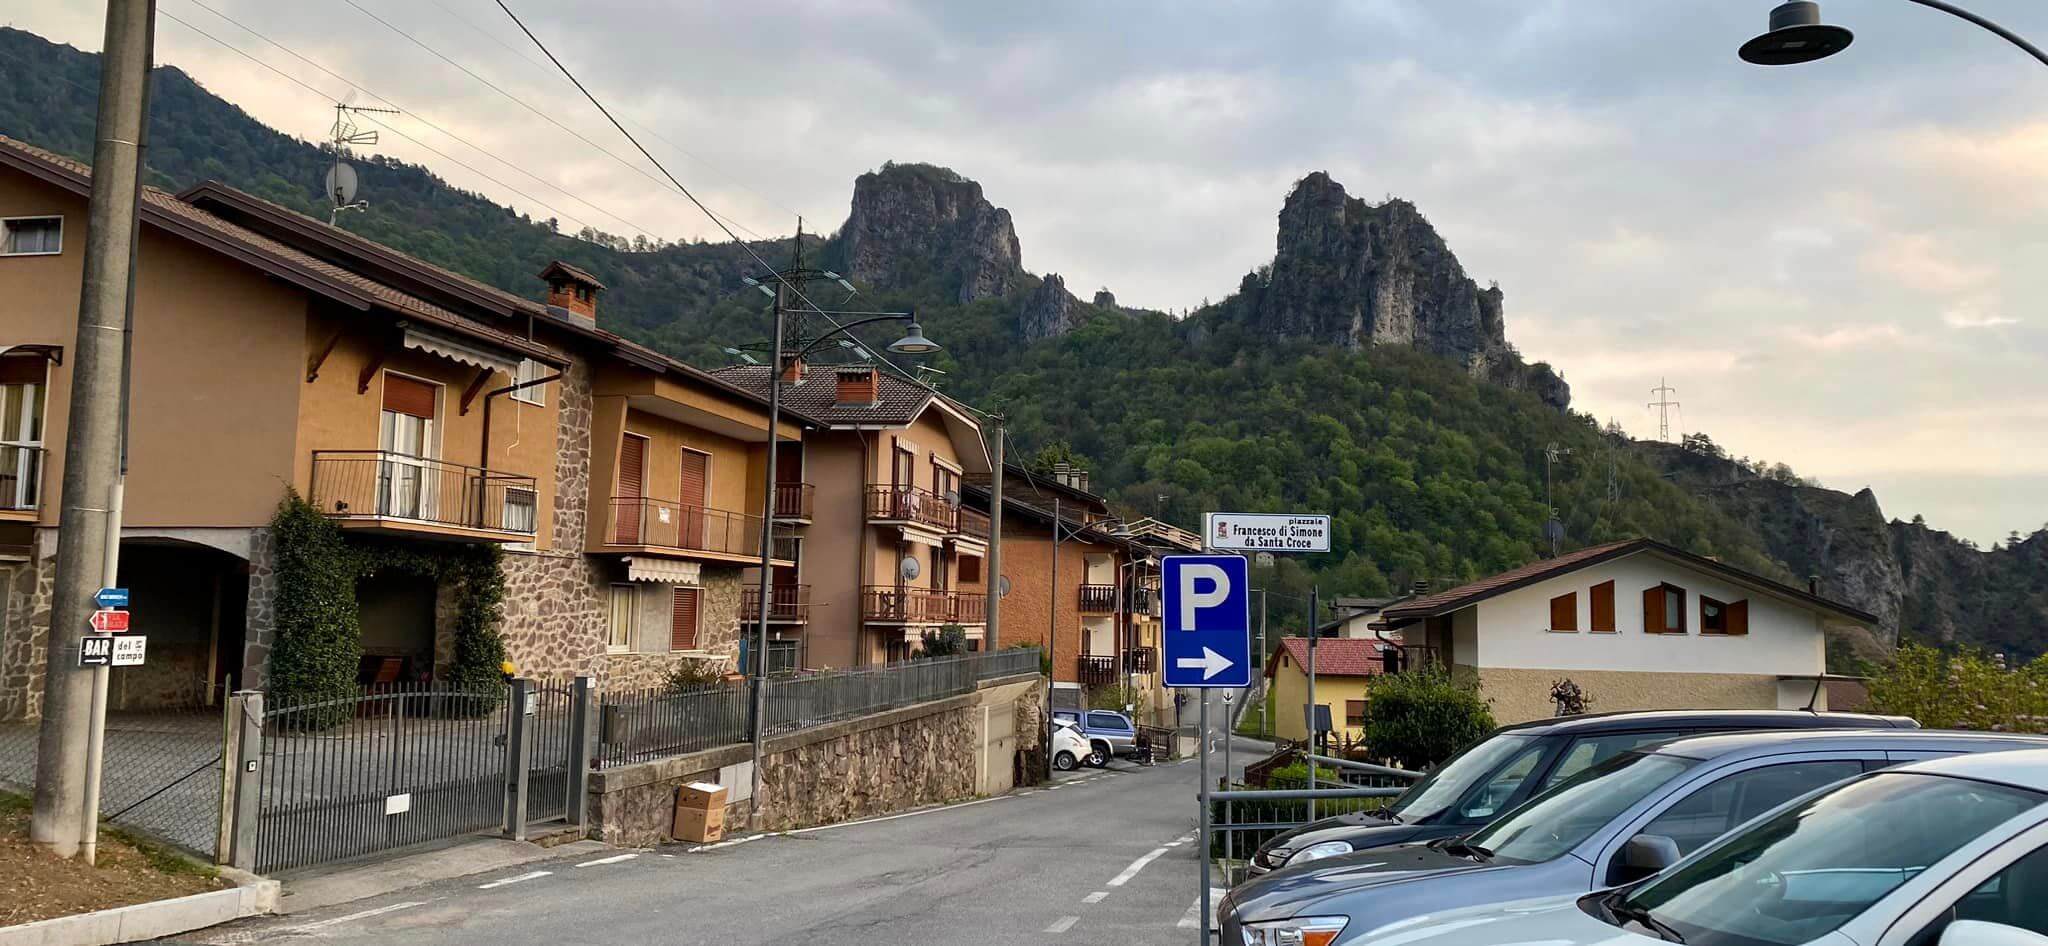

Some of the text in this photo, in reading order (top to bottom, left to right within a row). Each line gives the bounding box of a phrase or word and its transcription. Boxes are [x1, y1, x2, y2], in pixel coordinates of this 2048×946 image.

[1233, 525, 1323, 537] Francesco di Simone
[1245, 537, 1312, 548] da Santa Croce
[1180, 564, 1231, 631] P
[85, 640, 110, 656] BAR
[118, 640, 131, 650] del
[117, 653, 143, 662] campo
